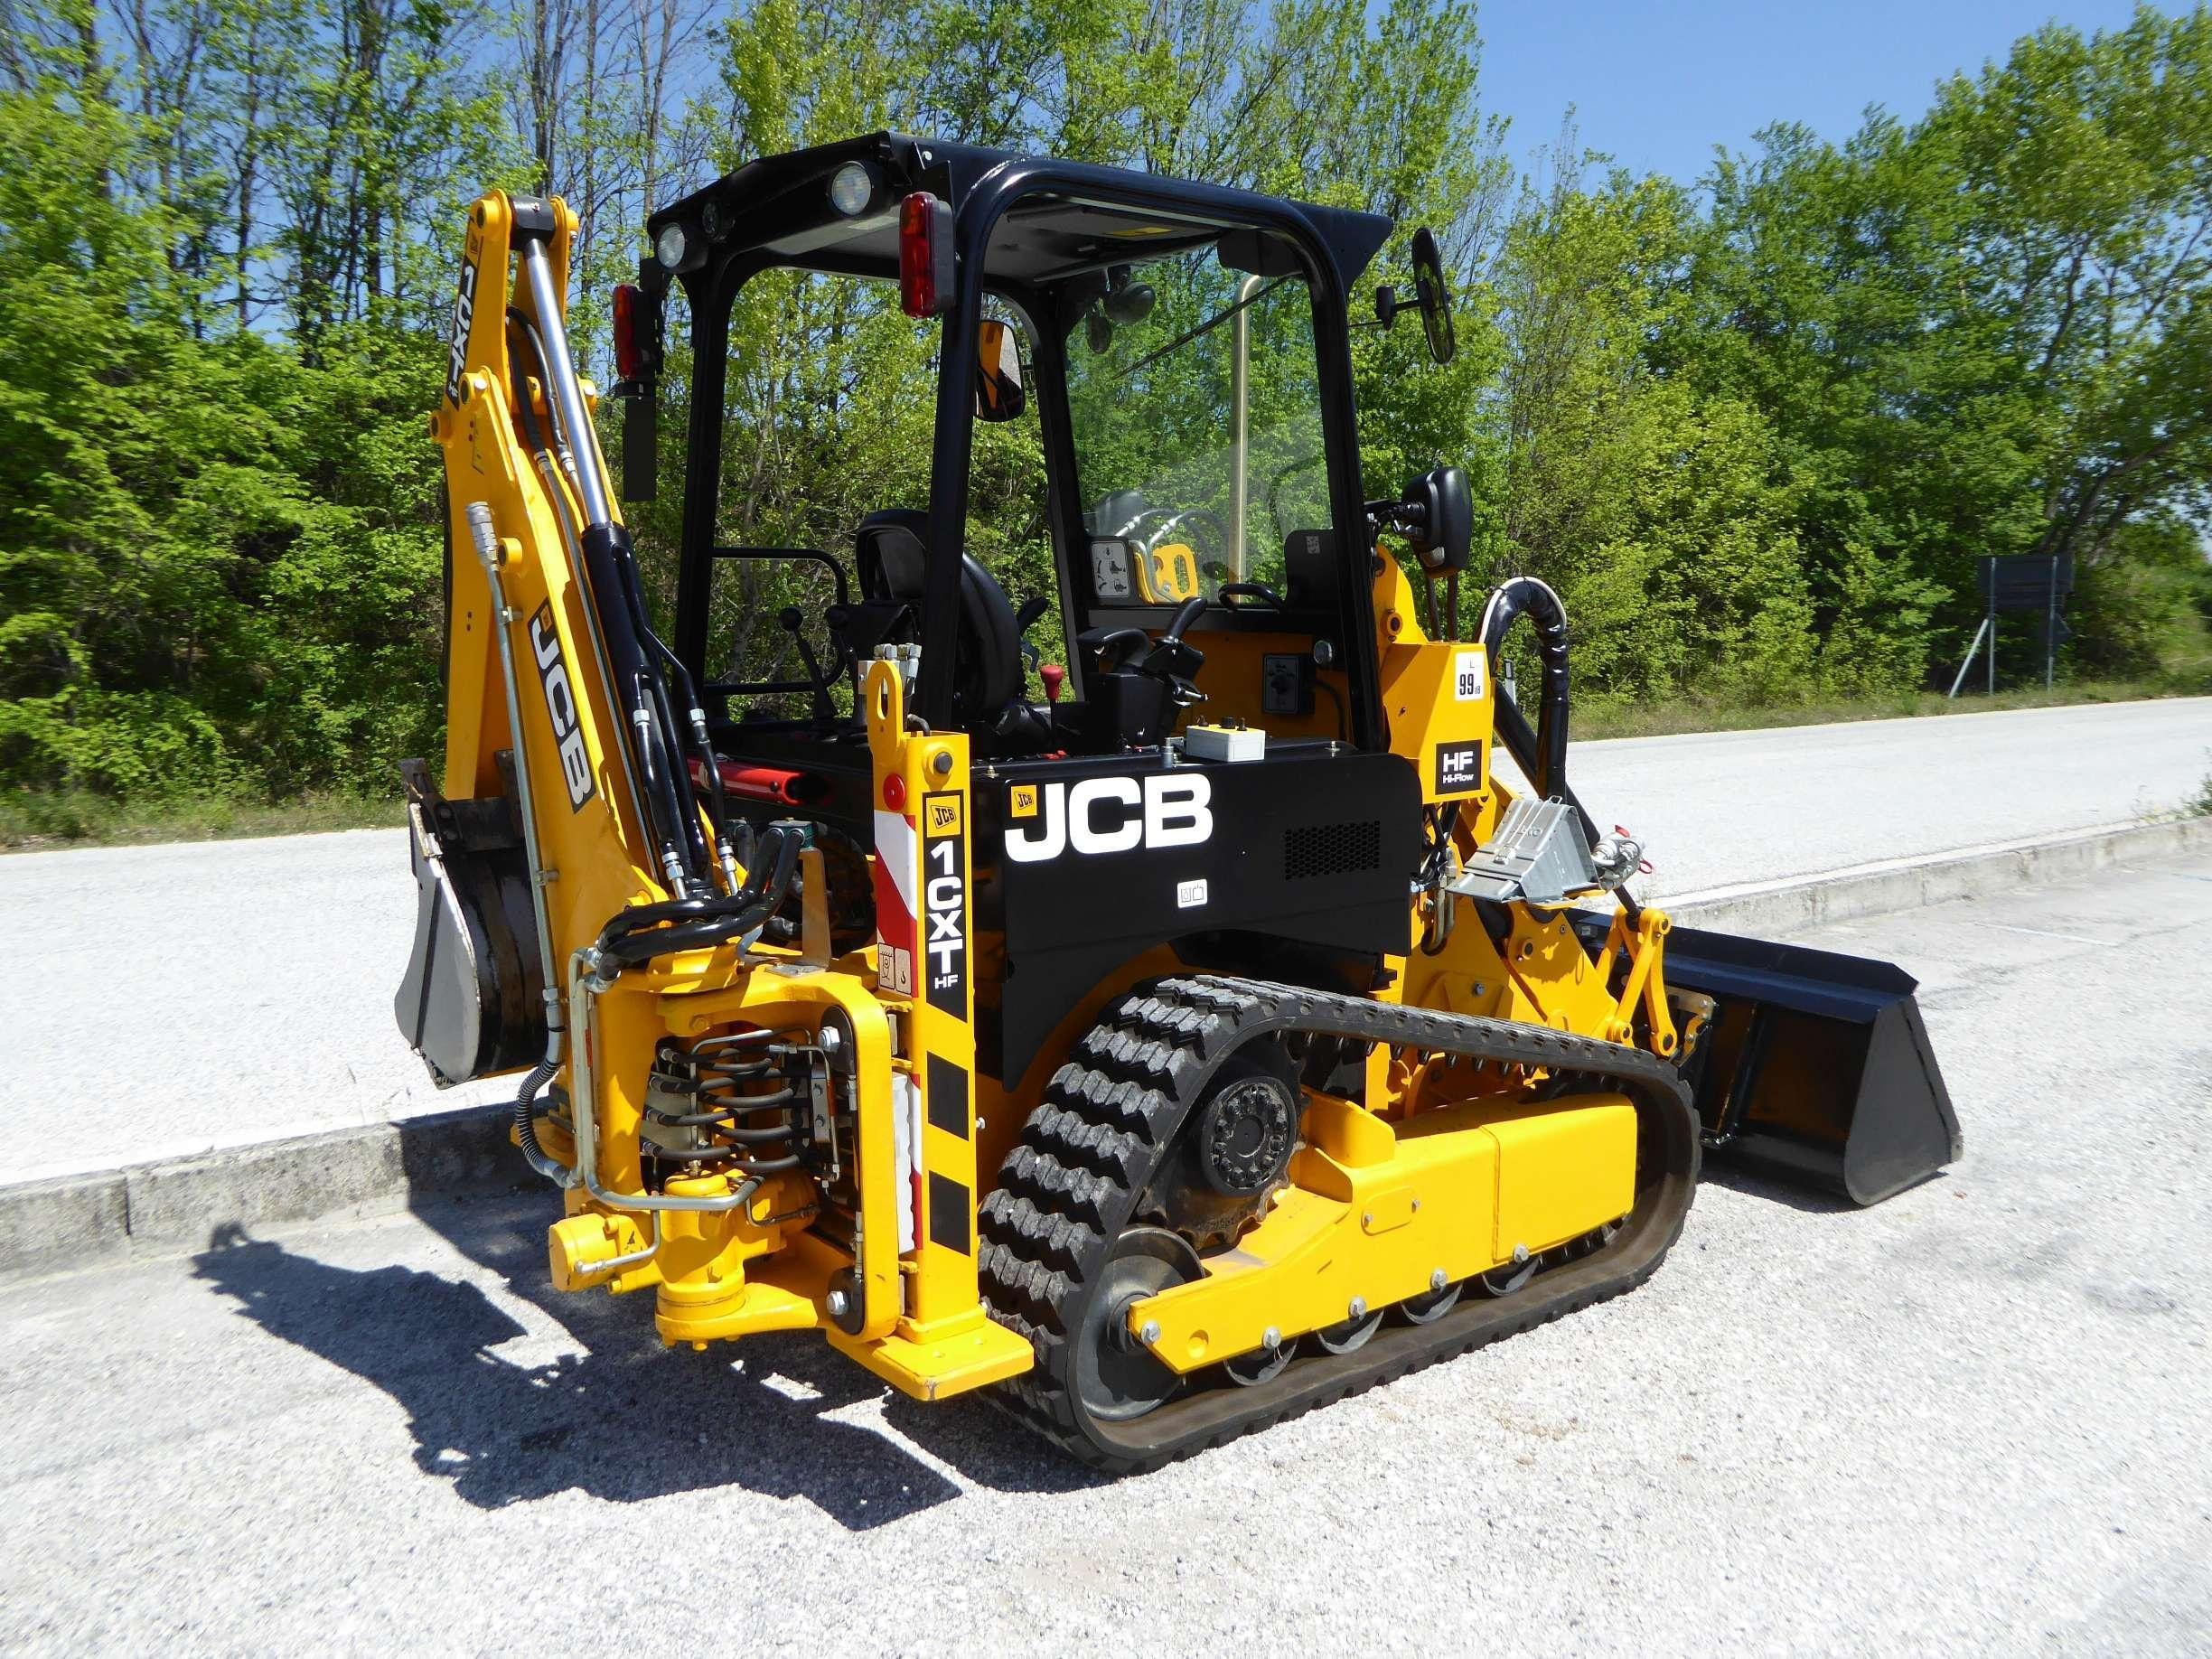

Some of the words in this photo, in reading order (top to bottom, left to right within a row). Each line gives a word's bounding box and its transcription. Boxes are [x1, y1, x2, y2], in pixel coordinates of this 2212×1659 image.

[452, 265, 474, 382] 1CXT
[1459, 673, 1475, 696] 99
[531, 617, 592, 805] JCB
[1443, 751, 1474, 773] HF
[1442, 773, 1474, 784] Hi-Flow
[1017, 792, 1033, 808] JCB
[934, 807, 955, 826] JCB
[1005, 773, 1214, 863] JCB
[927, 839, 963, 974] 1CXT
[934, 974, 959, 990] HF
